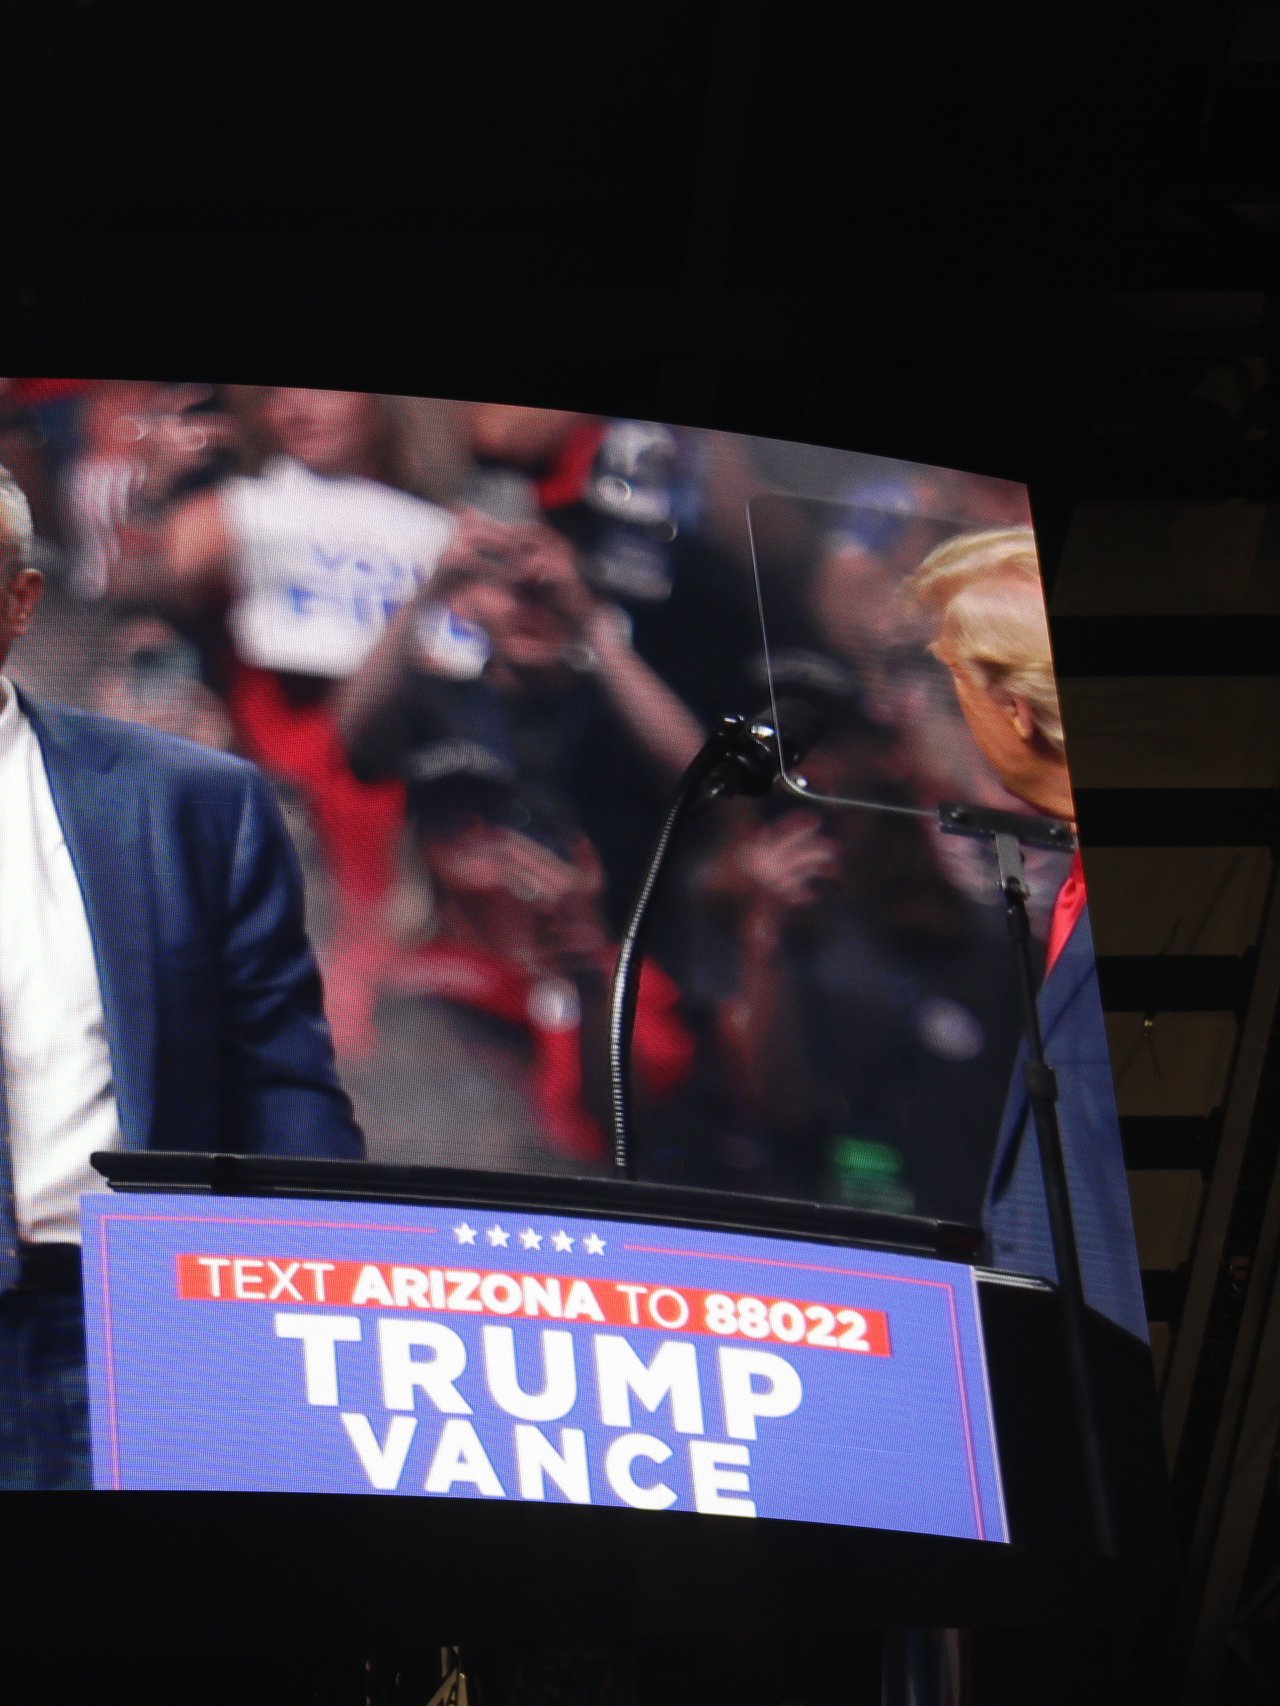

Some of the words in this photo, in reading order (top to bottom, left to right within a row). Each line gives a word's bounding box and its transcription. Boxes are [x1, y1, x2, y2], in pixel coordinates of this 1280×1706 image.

[197, 1256, 335, 1302] TEXT
[351, 1264, 606, 1323] ARIZONA
[614, 1283, 690, 1330] TO
[703, 1292, 870, 1352] 88022
[272, 1311, 803, 1441] TRUMP
[338, 1411, 758, 1518] VANCE
